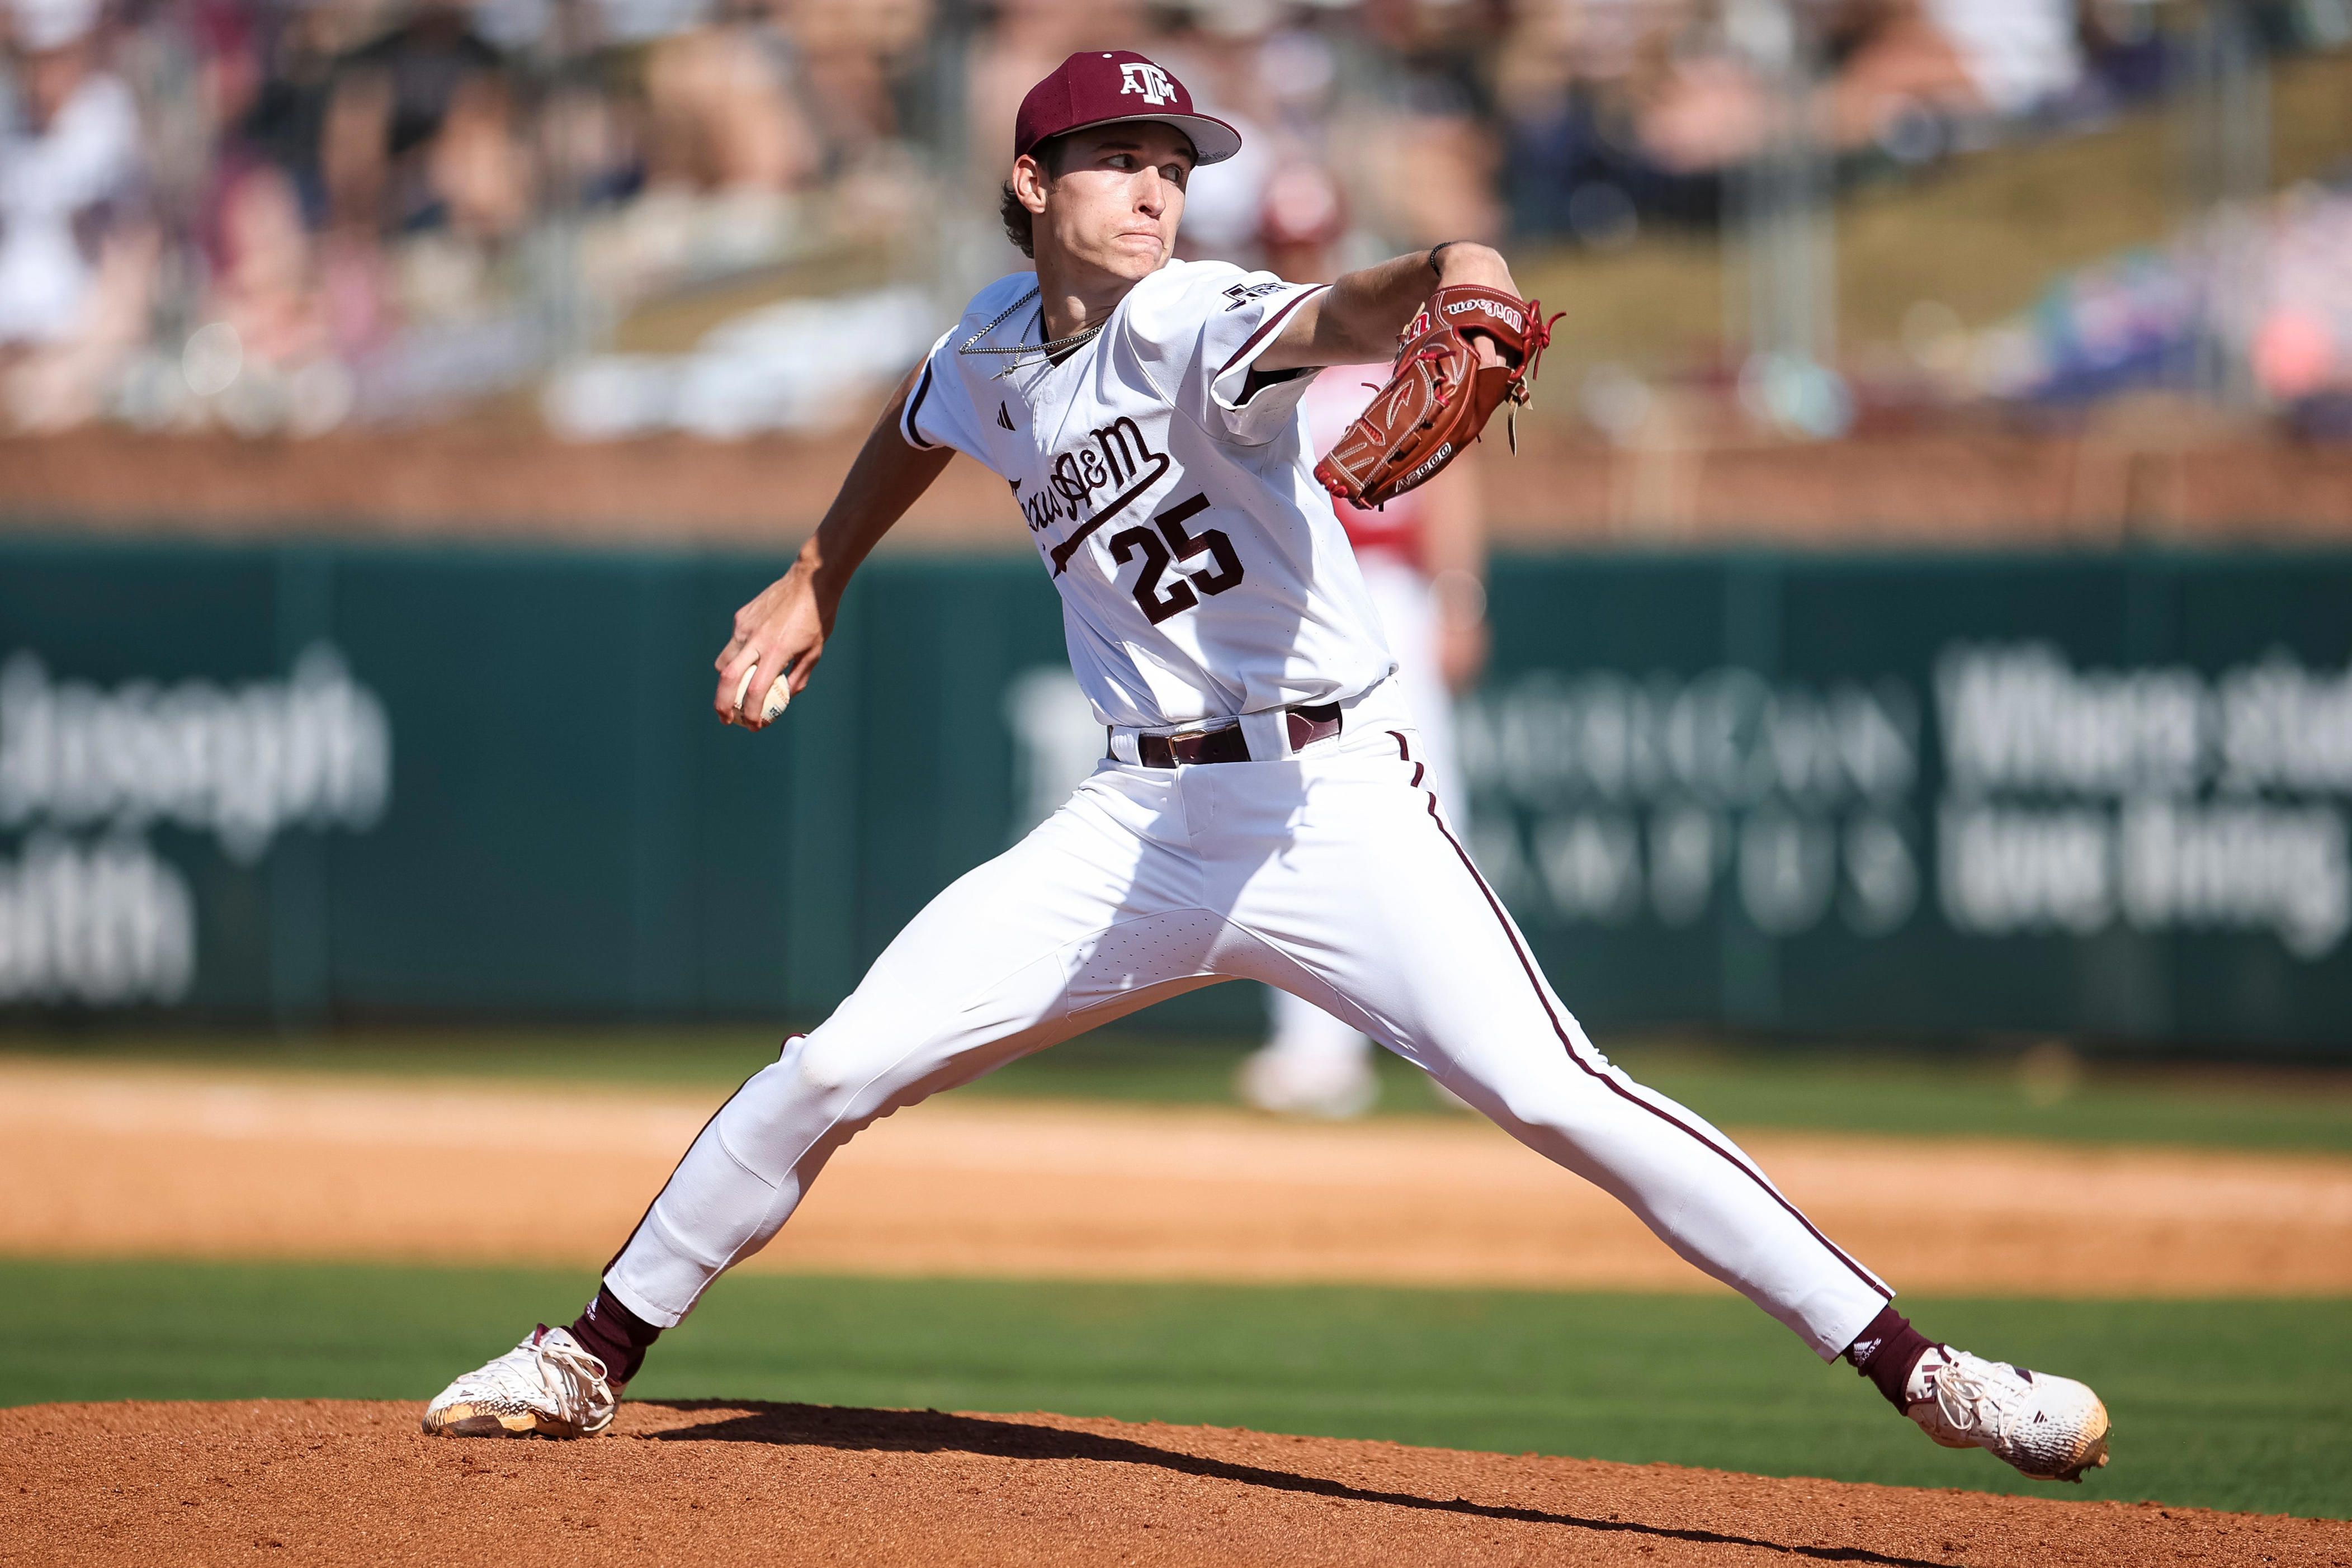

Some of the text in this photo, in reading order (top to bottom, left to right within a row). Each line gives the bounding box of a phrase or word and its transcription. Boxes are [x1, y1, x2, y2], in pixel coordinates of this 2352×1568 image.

[1449, 298, 1522, 334] Wilson
[1051, 416, 1170, 526] A&M
[1395, 442, 1452, 493] A2000
[1108, 492, 1245, 626] 25
